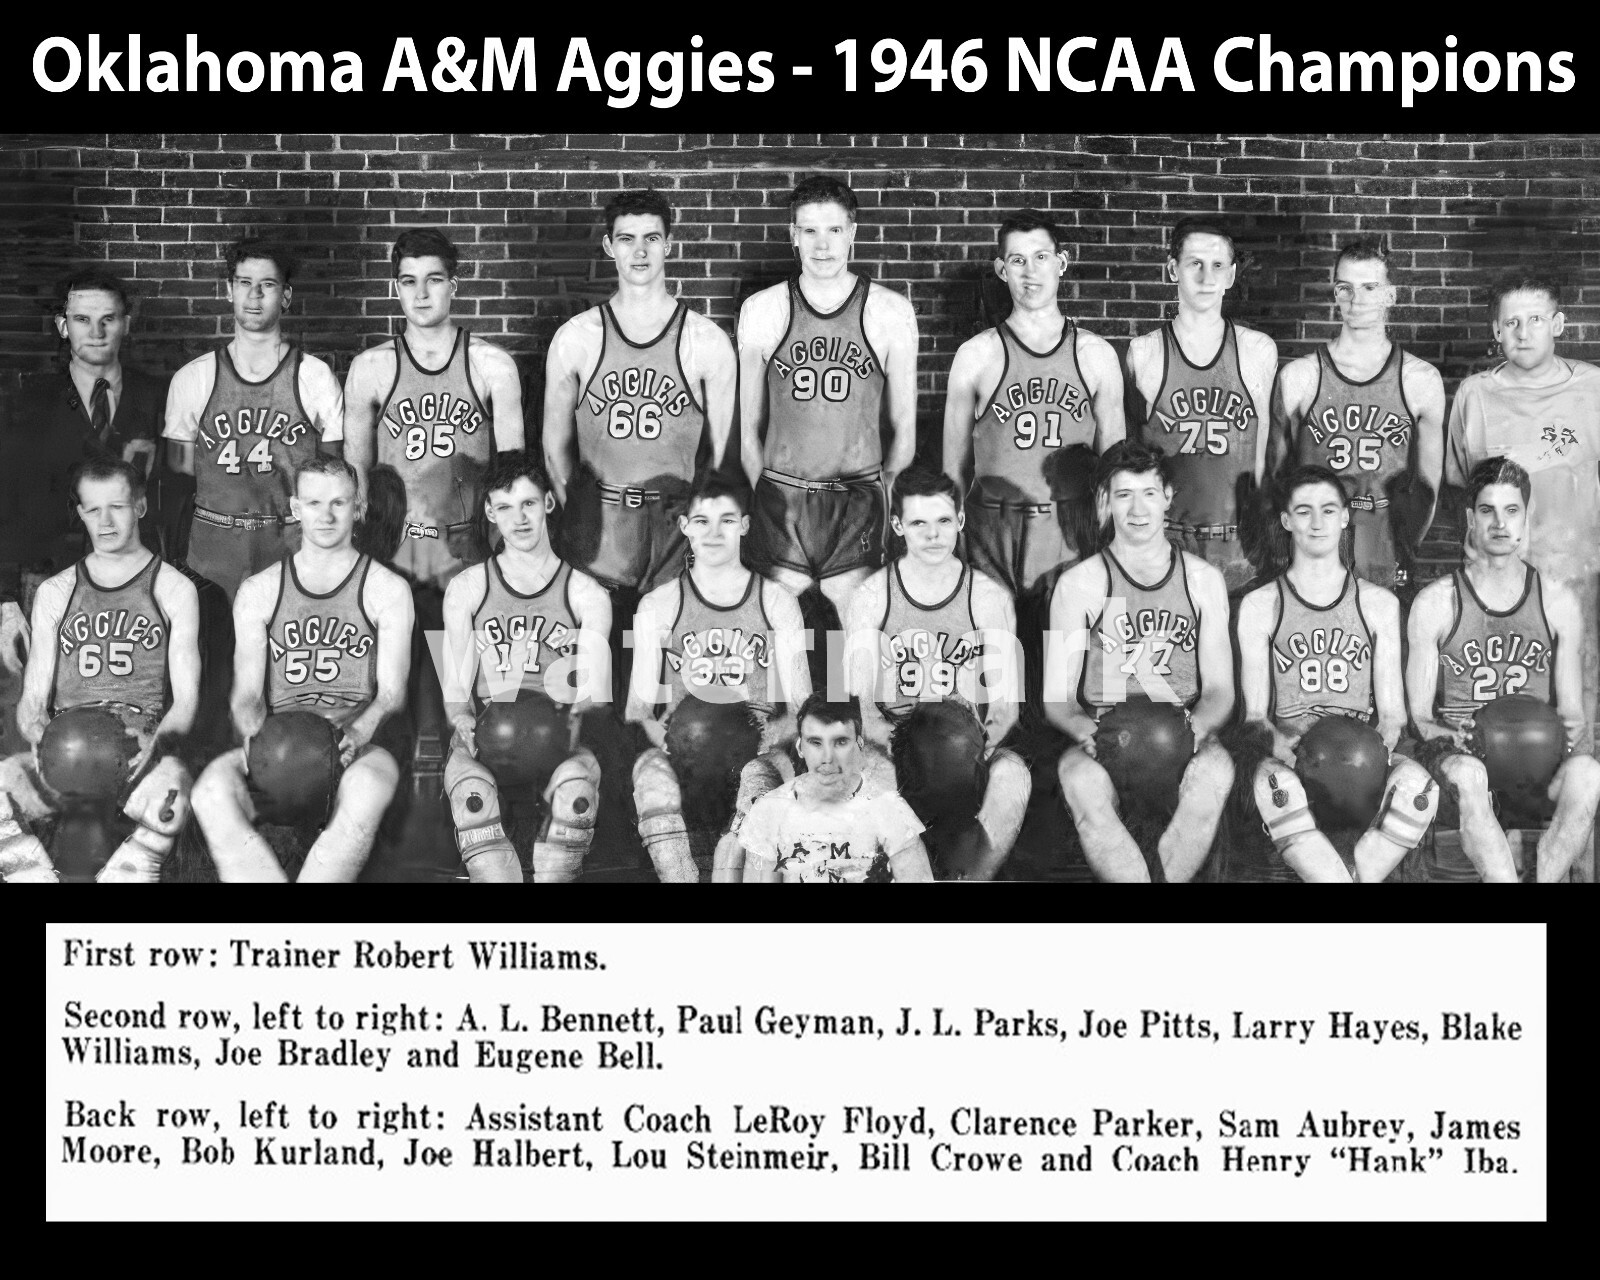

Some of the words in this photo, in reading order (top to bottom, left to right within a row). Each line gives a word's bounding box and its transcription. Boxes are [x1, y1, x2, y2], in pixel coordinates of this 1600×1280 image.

[774, 336, 874, 380] AGGIES
[587, 368, 691, 416] AGGIES
[792, 367, 851, 402] 90
[991, 377, 1090, 424] AGGIES
[382, 393, 484, 439] AGGIES
[608, 402, 662, 439] 66
[1156, 387, 1256, 432] AGGIES
[1308, 405, 1412, 446] AGGIES
[200, 408, 306, 449] AGGIES
[405, 424, 456, 460] 85
[1014, 412, 1062, 449] 91
[1178, 421, 1229, 455] 75
[217, 439, 273, 474] 44
[1328, 436, 1382, 470] 35
[60, 610, 162, 655] AGGIES
[269, 617, 374, 661] AGGIES
[1098, 609, 1197, 654] AGGIES
[78, 642, 135, 677] 65
[284, 649, 340, 683] 55
[495, 640, 540, 673] 11
[691, 656, 745, 686] 33
[1119, 641, 1173, 675] 77
[899, 661, 956, 697] 99
[1300, 658, 1348, 692] 88
[1472, 666, 1528, 701] 22
